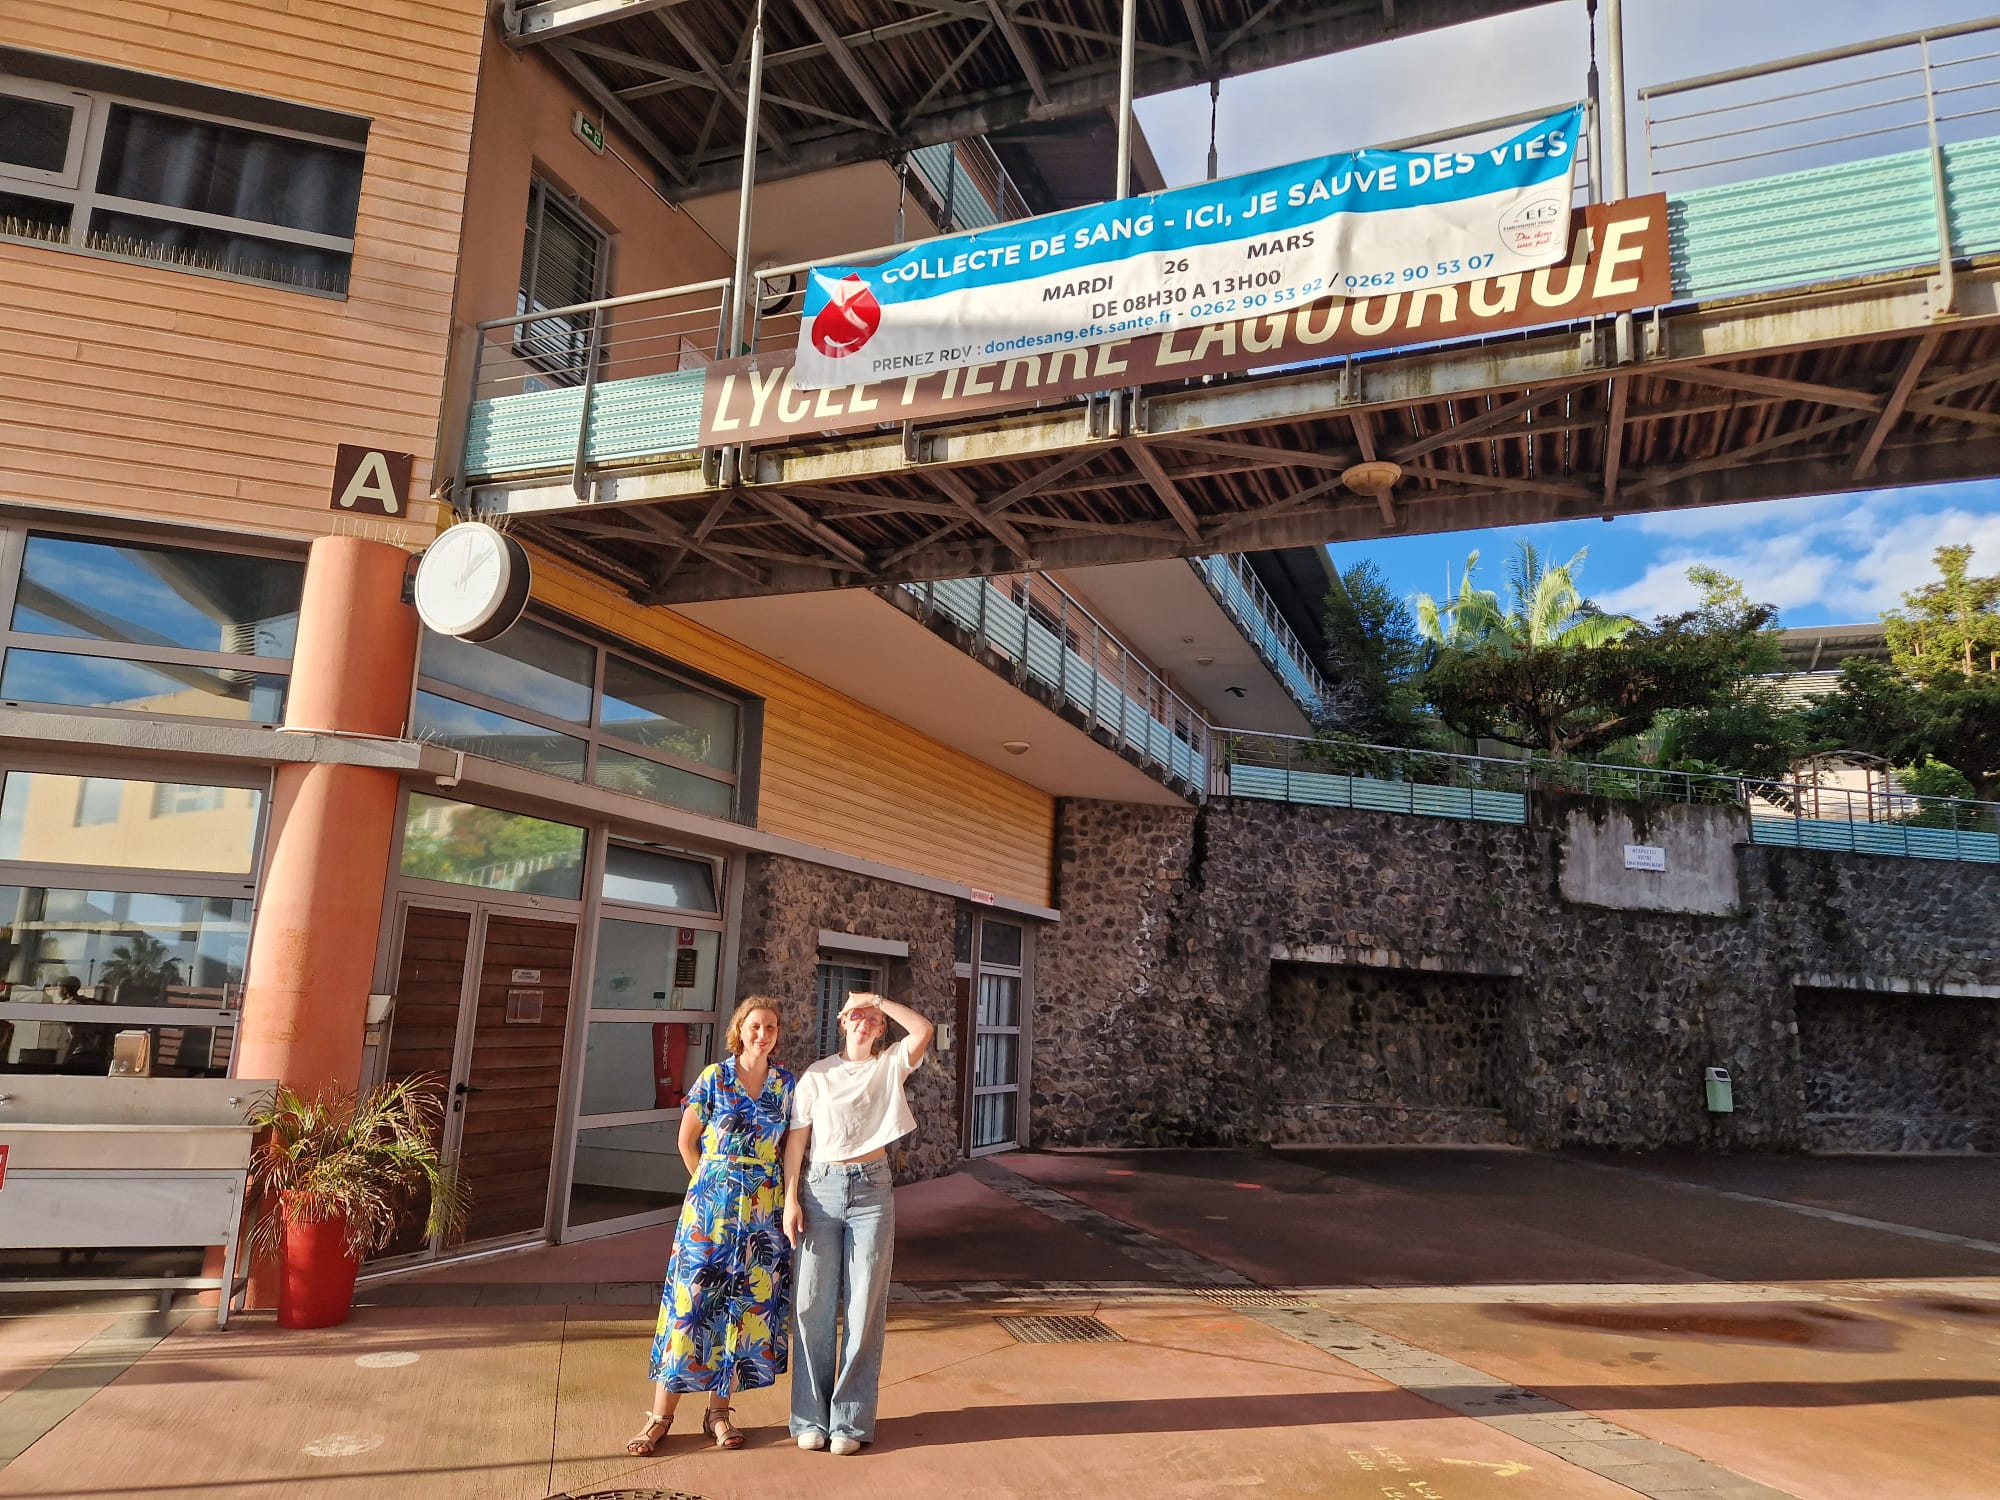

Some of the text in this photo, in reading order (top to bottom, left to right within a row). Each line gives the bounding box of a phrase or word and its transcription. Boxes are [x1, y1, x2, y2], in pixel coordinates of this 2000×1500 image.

[881, 130, 1568, 284] COLLECTE DE SANG - ICI, JE SAUVE DES VIES
[1526, 204, 1558, 220] EFS
[1042, 231, 1315, 302] MARDI 26 MARS
[1092, 270, 1281, 319] DE 08H30 A 13H00
[873, 352, 933, 373] PRENEZ
[939, 345, 973, 362] RDV
[984, 310, 1172, 354] dondesang.efs.sante.fr
[1190, 295, 1236, 318] 0262
[1242, 293, 1267, 309] 90
[1273, 287, 1295, 304] 53
[1302, 277, 1323, 296] 92
[1328, 272, 1339, 288] /
[1345, 271, 1395, 288] 0262
[1402, 265, 1428, 281] 90
[1437, 261, 1460, 276] 53
[1468, 253, 1495, 270] 07
[340, 452, 399, 514] A
